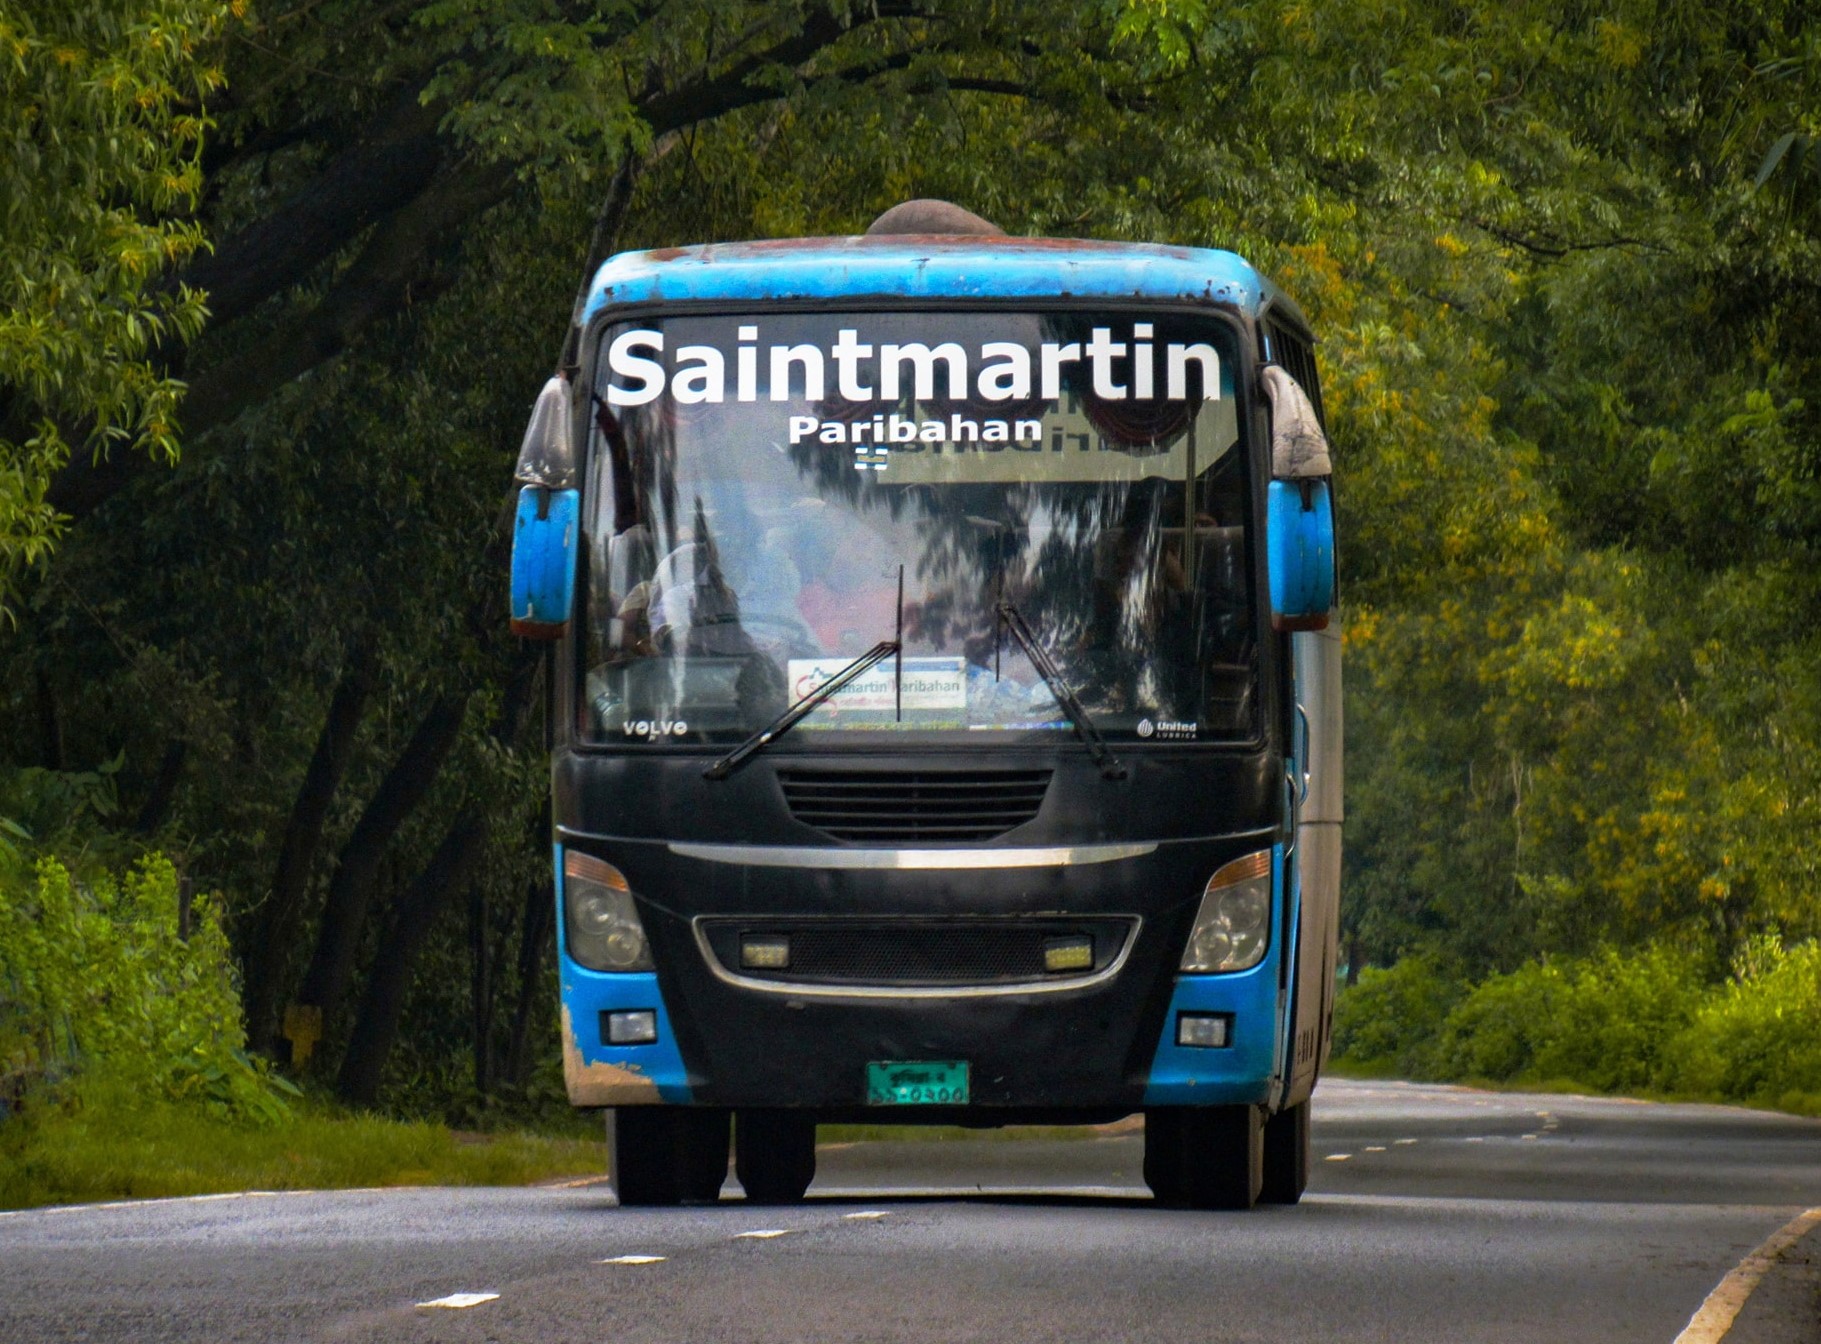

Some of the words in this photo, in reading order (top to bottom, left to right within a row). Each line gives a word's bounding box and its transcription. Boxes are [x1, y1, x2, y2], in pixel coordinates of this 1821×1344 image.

[606, 323, 1221, 406] Saintmartin
[788, 414, 1042, 445] Paribahan
[623, 720, 688, 736] VOLVO
